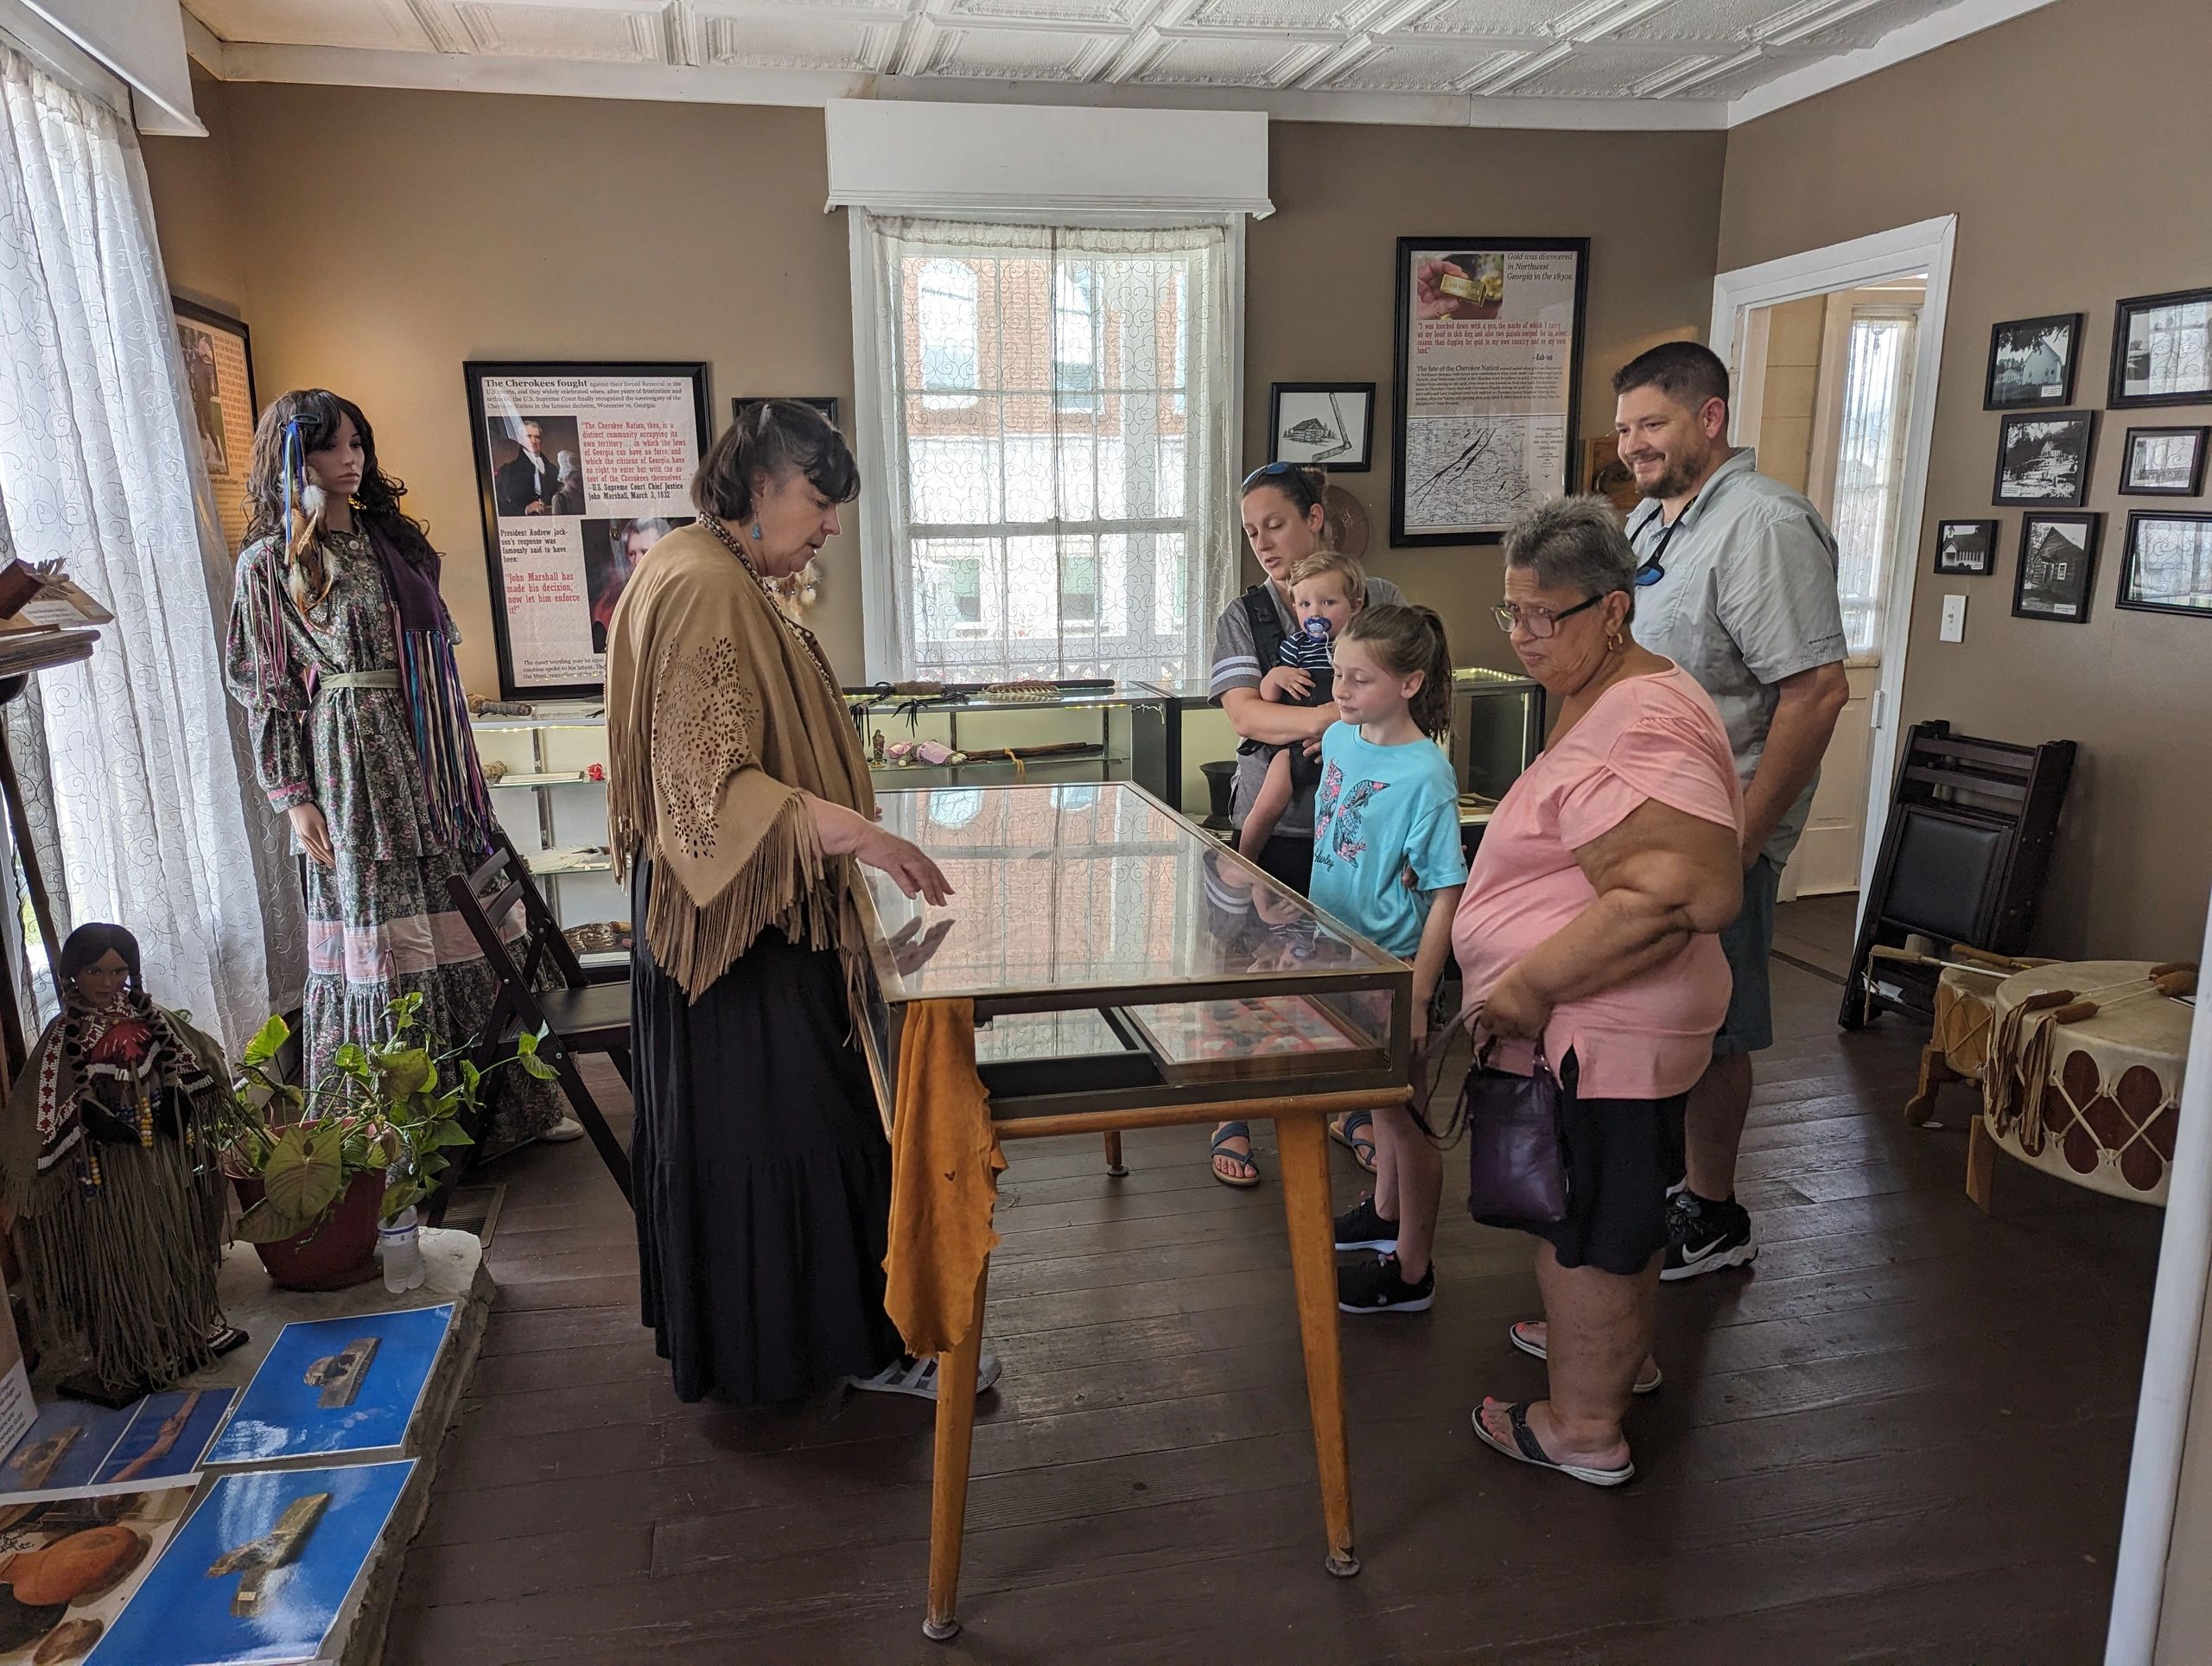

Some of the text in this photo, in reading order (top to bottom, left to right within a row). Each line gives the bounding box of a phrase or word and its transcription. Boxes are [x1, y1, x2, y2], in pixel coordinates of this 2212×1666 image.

[1507, 273, 1533, 282] Georgia
[557, 379, 587, 389] fought
[606, 431, 637, 440] community
[640, 431, 668, 439] occupying
[592, 449, 614, 457] Georgia
[648, 457, 670, 465] Georgia
[595, 467, 609, 475] right
[604, 484, 628, 492] Supreme
[589, 492, 601, 501] John
[603, 492, 629, 500] Marshall,
[502, 547, 528, 555] famously
[528, 573, 558, 581] Marshall
[506, 583, 573, 593] made his decision,
[538, 594, 552, 602] him
[554, 593, 580, 602] enforce
[1314, 847, 1334, 873] Hurley
